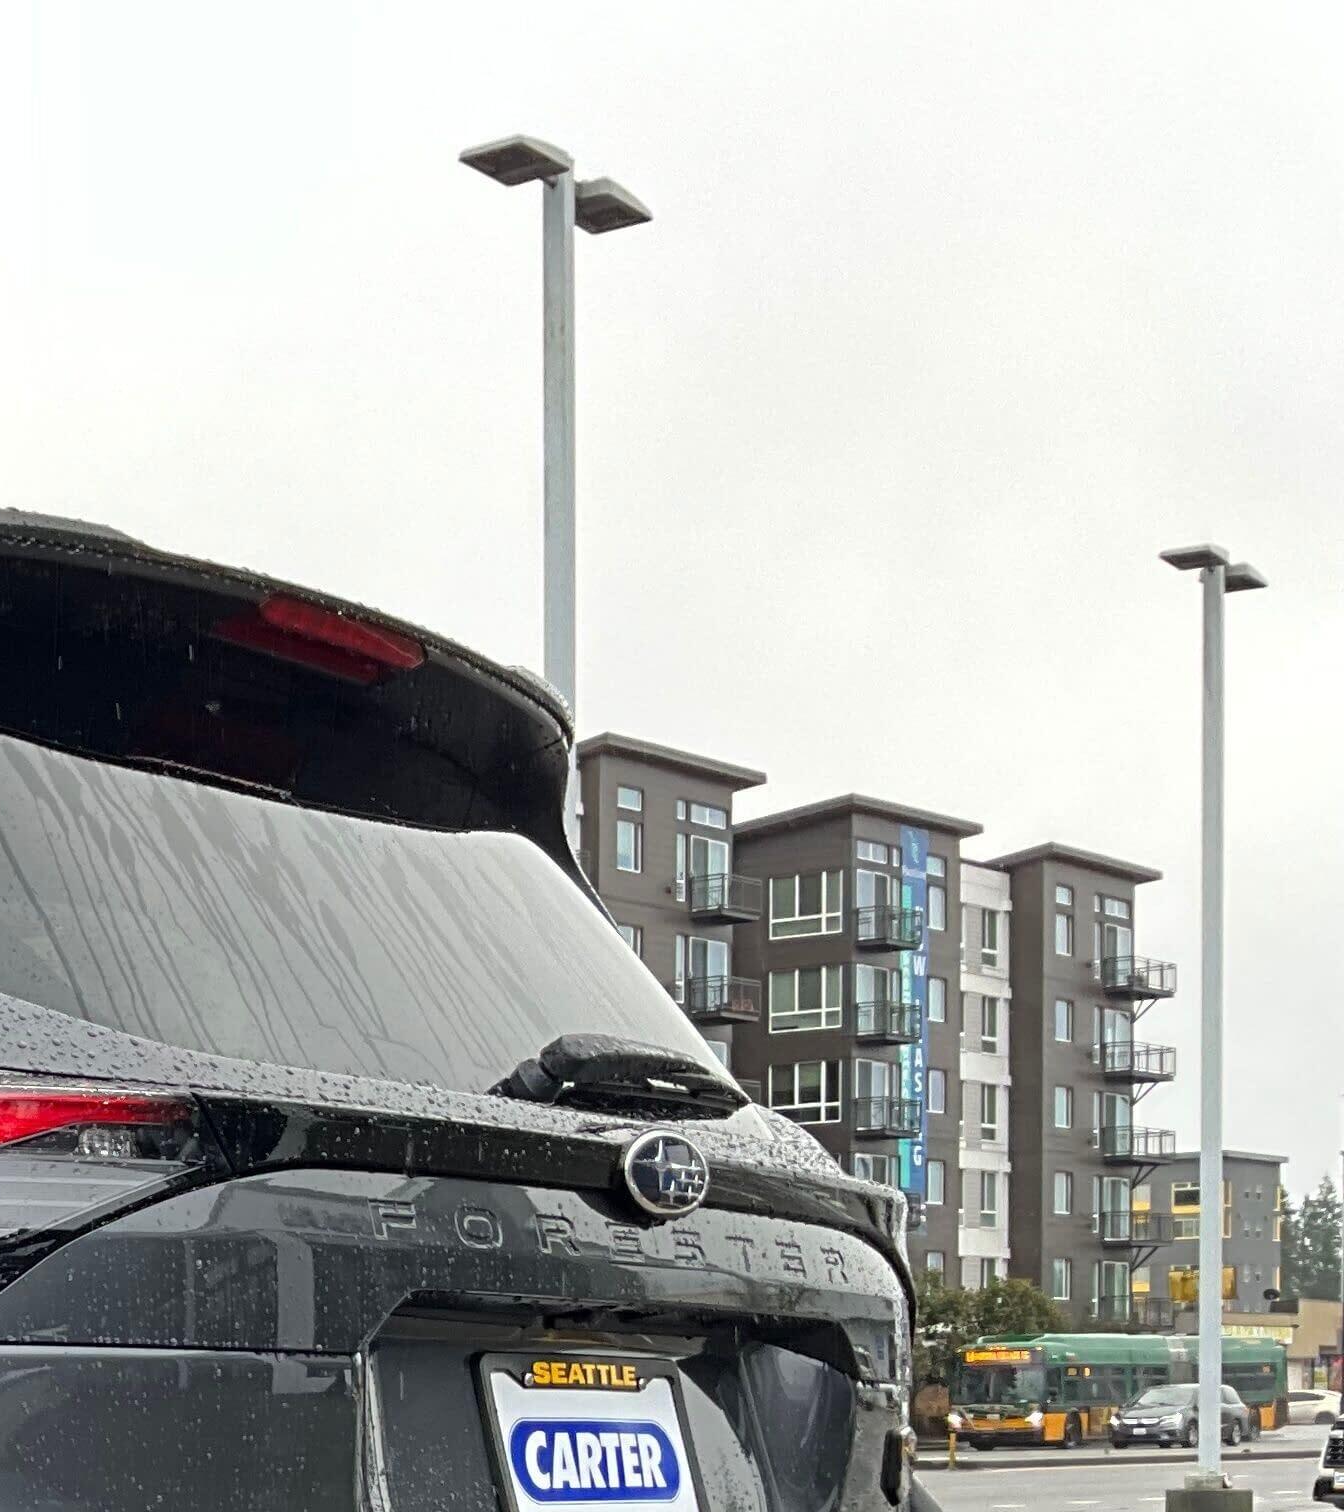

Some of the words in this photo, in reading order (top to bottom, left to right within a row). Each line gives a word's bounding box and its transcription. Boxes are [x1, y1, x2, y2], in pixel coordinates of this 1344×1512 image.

[368, 1199, 850, 1286] FORESTER
[532, 1361, 637, 1387] SEATTLE
[525, 1430, 667, 1490] CARTER
